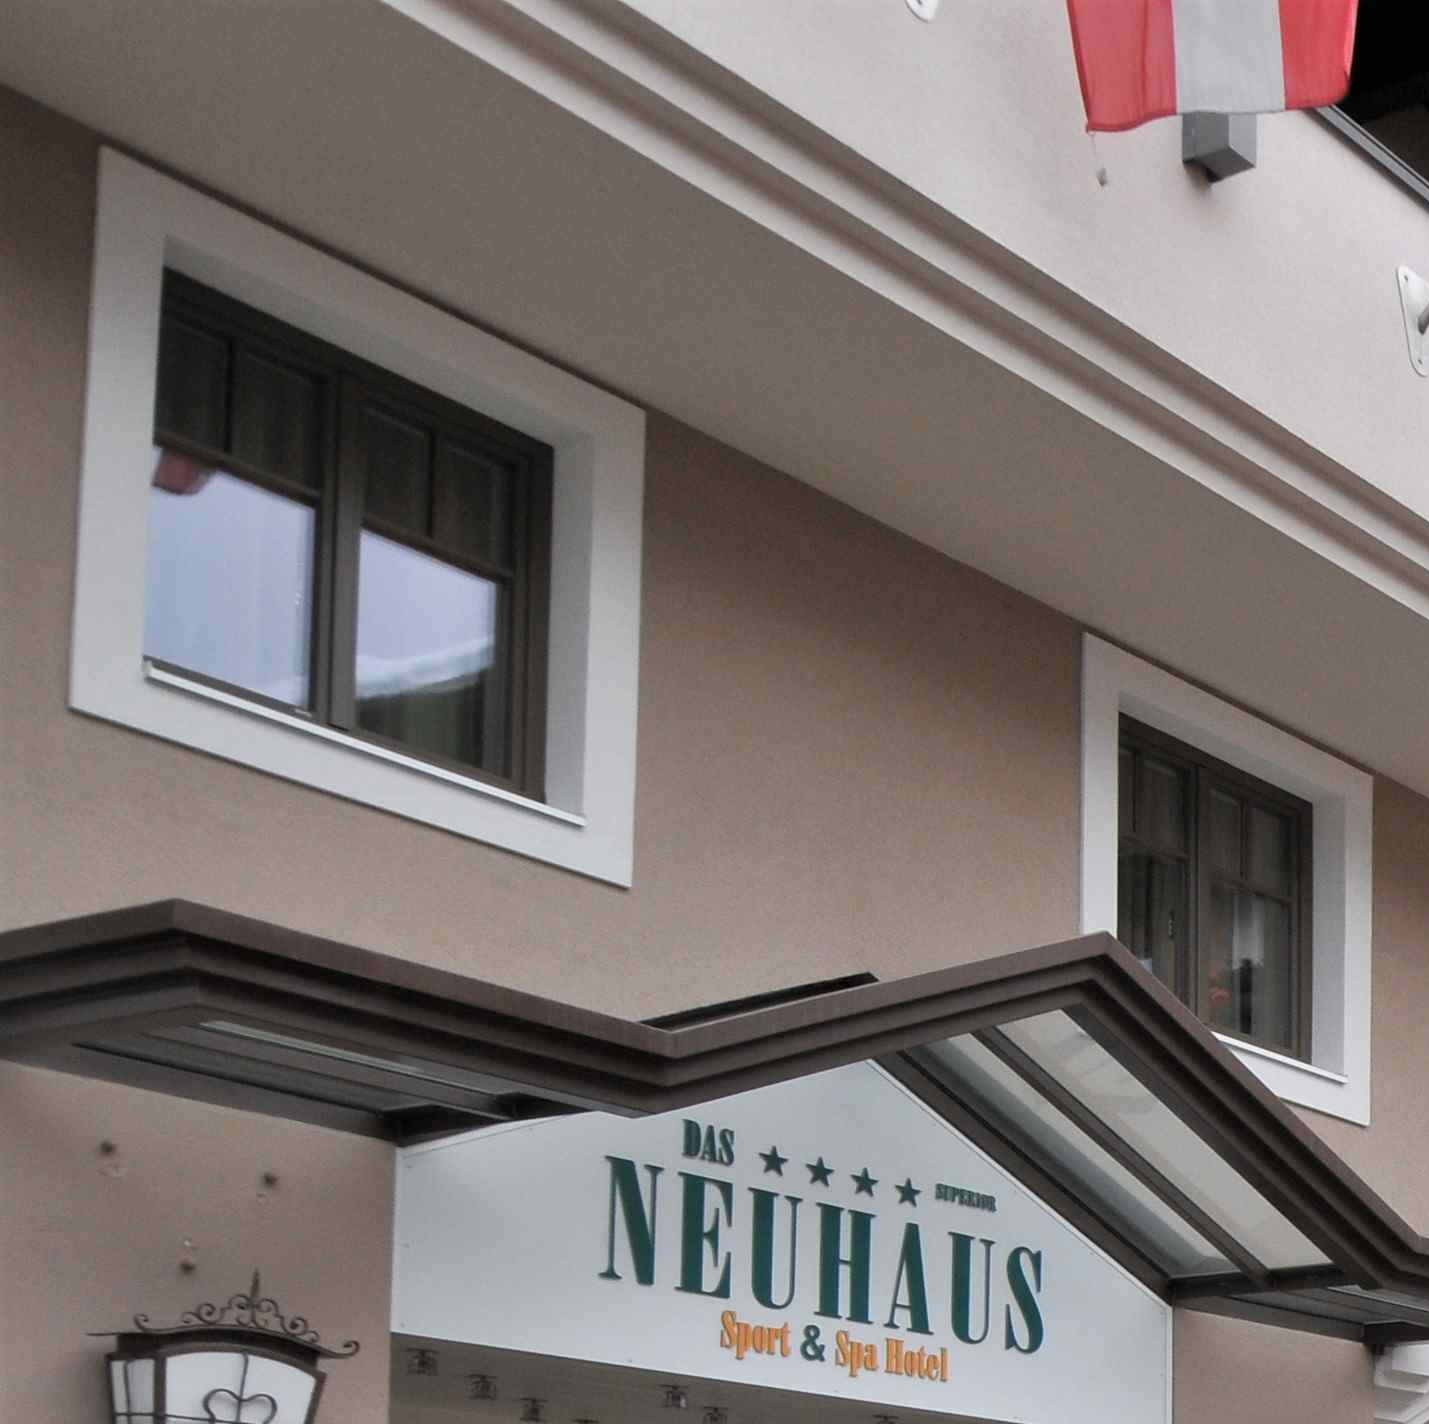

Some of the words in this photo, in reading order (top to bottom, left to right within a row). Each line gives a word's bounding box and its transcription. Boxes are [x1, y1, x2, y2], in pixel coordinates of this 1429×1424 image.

[682, 1119, 734, 1167] DAS
[598, 1155, 1045, 1355] NEUHAUS
[720, 1310, 791, 1361] Sport
[801, 1324, 827, 1362] &
[835, 1329, 879, 1377] Spa
[885, 1339, 949, 1382] Hotel
